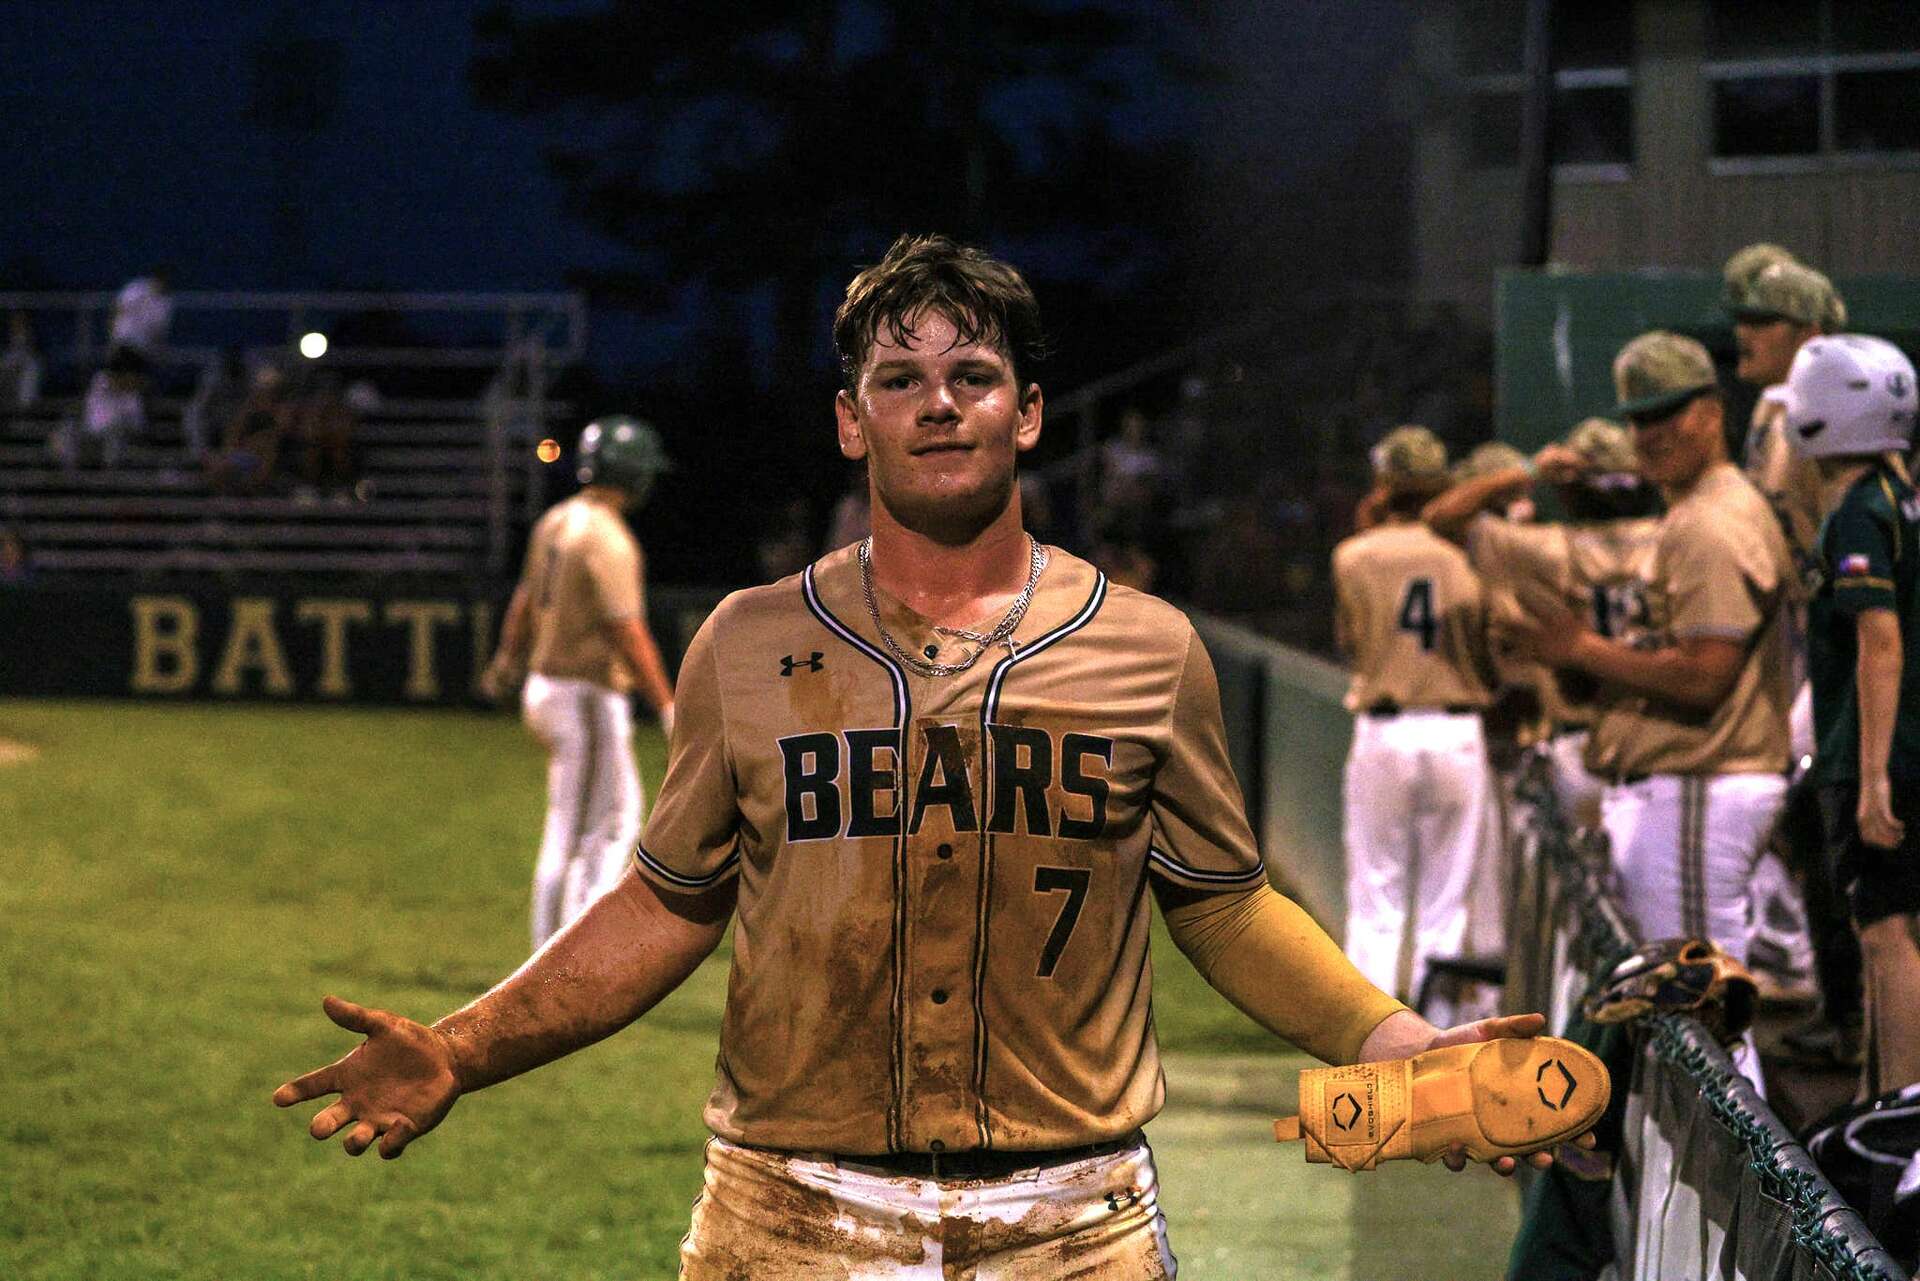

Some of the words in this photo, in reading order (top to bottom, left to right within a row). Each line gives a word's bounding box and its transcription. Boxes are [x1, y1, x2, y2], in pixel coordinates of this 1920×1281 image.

[1399, 579, 1437, 651] 4
[776, 723, 1114, 843] BEARS
[1033, 865, 1092, 979] 7
